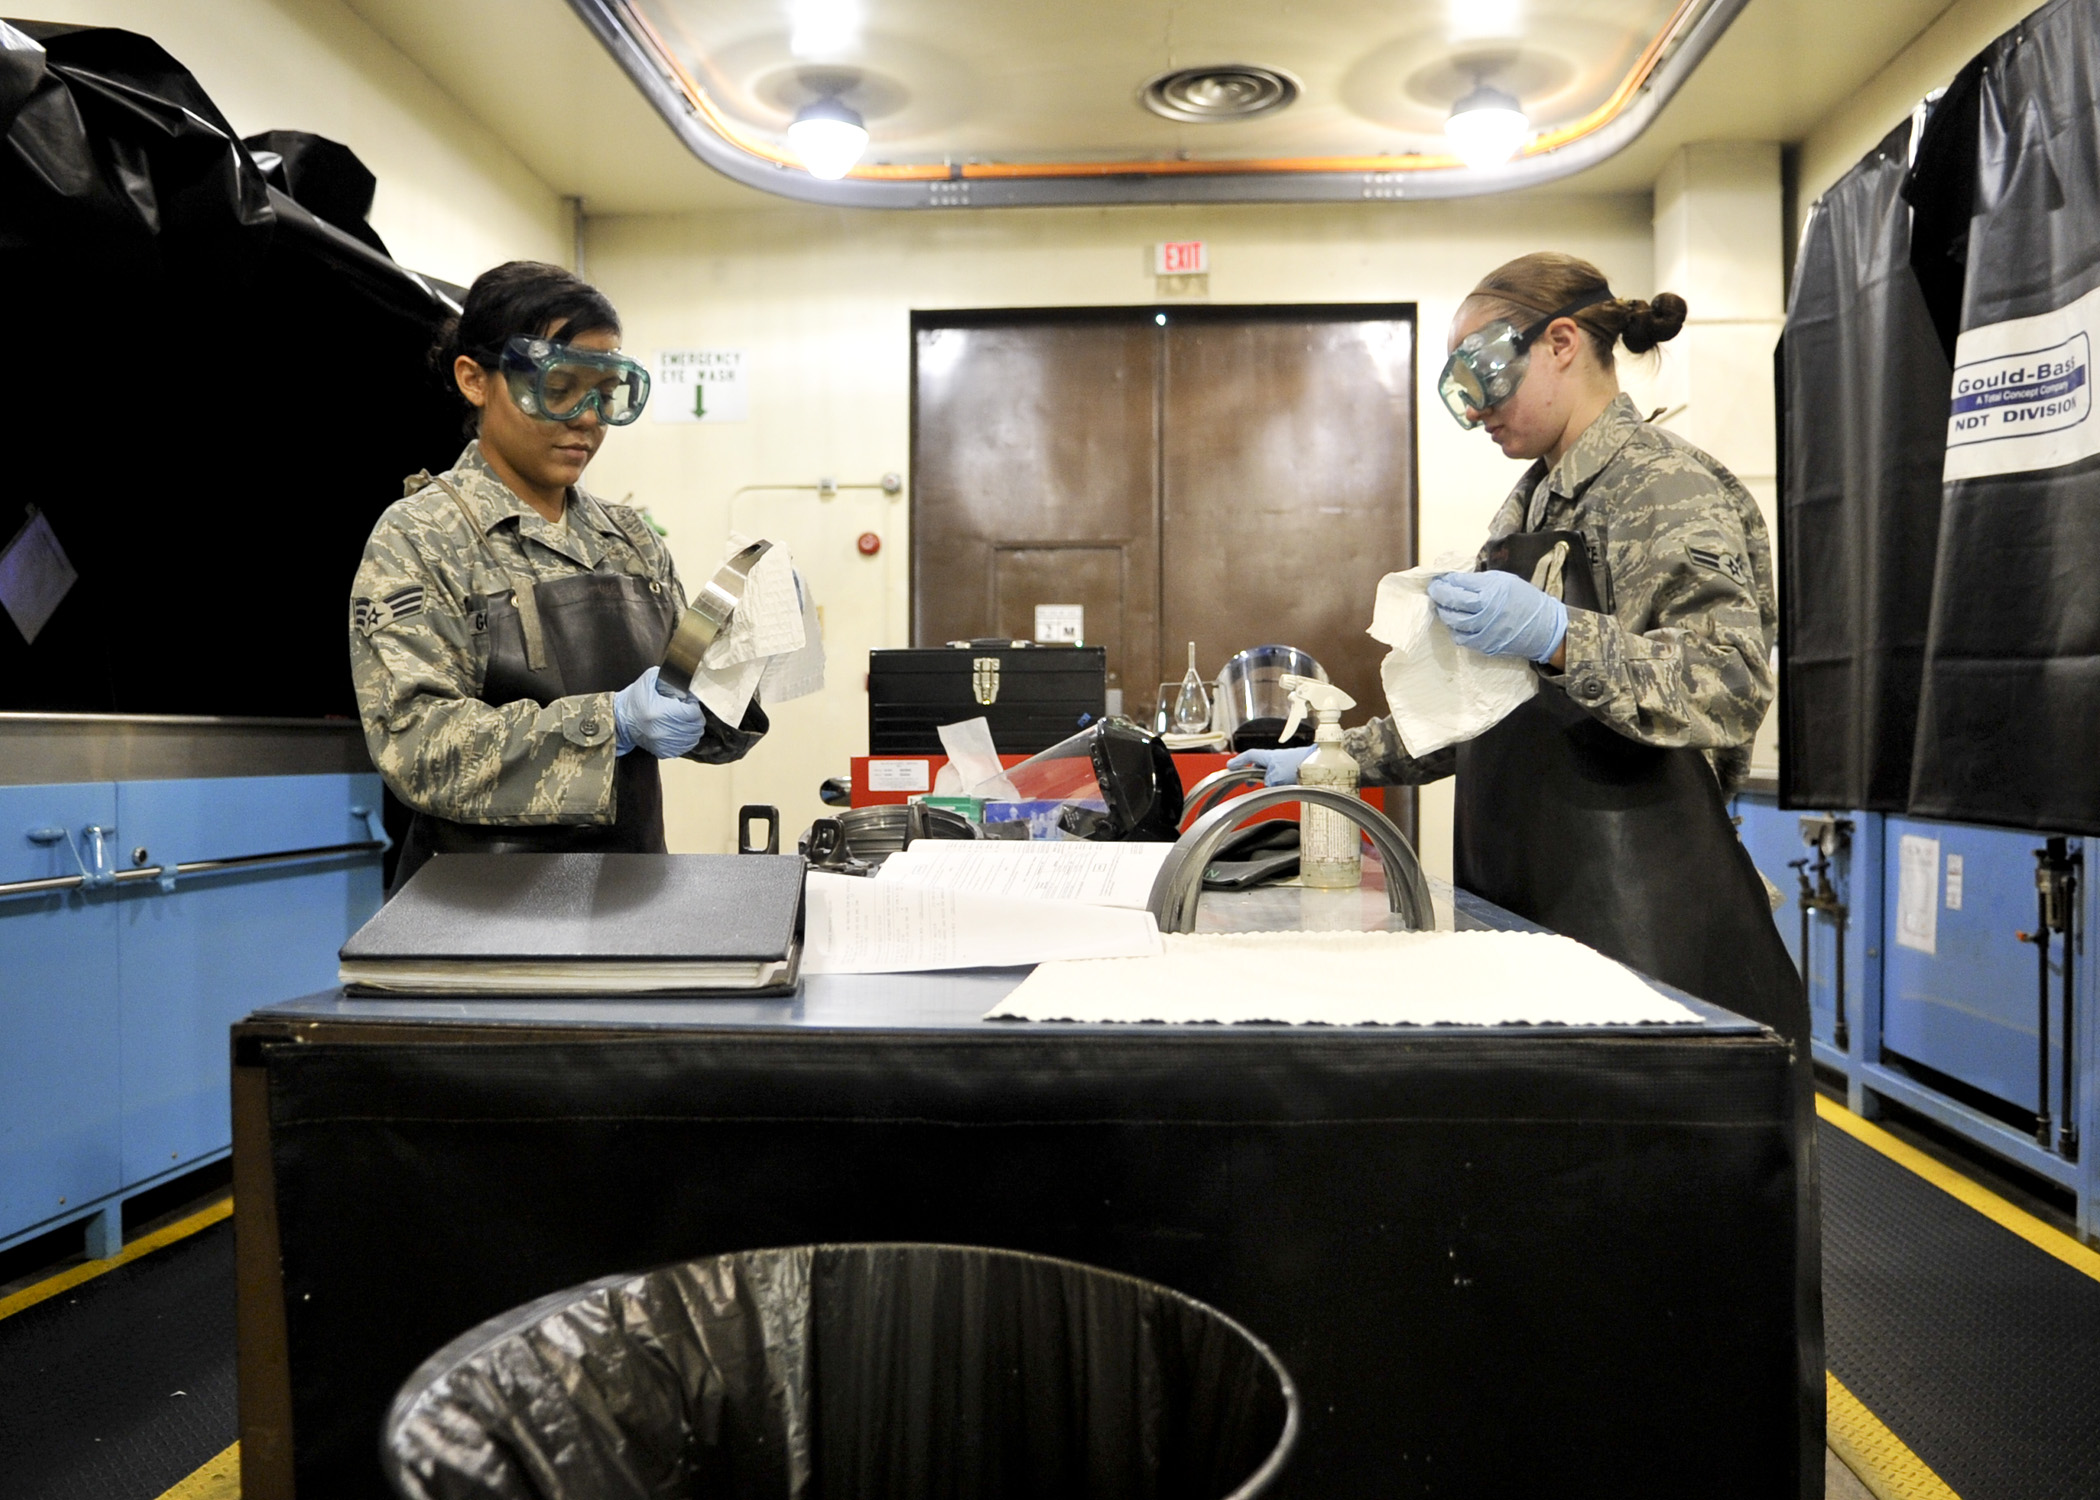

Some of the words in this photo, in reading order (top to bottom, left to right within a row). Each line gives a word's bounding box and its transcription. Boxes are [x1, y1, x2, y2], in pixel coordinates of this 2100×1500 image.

[1164, 241, 1202, 272] EXIT
[661, 352, 740, 367] EMERGENCY
[661, 370, 685, 384] EYE
[699, 370, 736, 382] WASH
[1975, 396, 1984, 405] A
[1984, 392, 2002, 404] Total
[2003, 388, 2038, 400] Concept
[2040, 381, 2069, 395] Company
[1955, 414, 1990, 431] NDT
